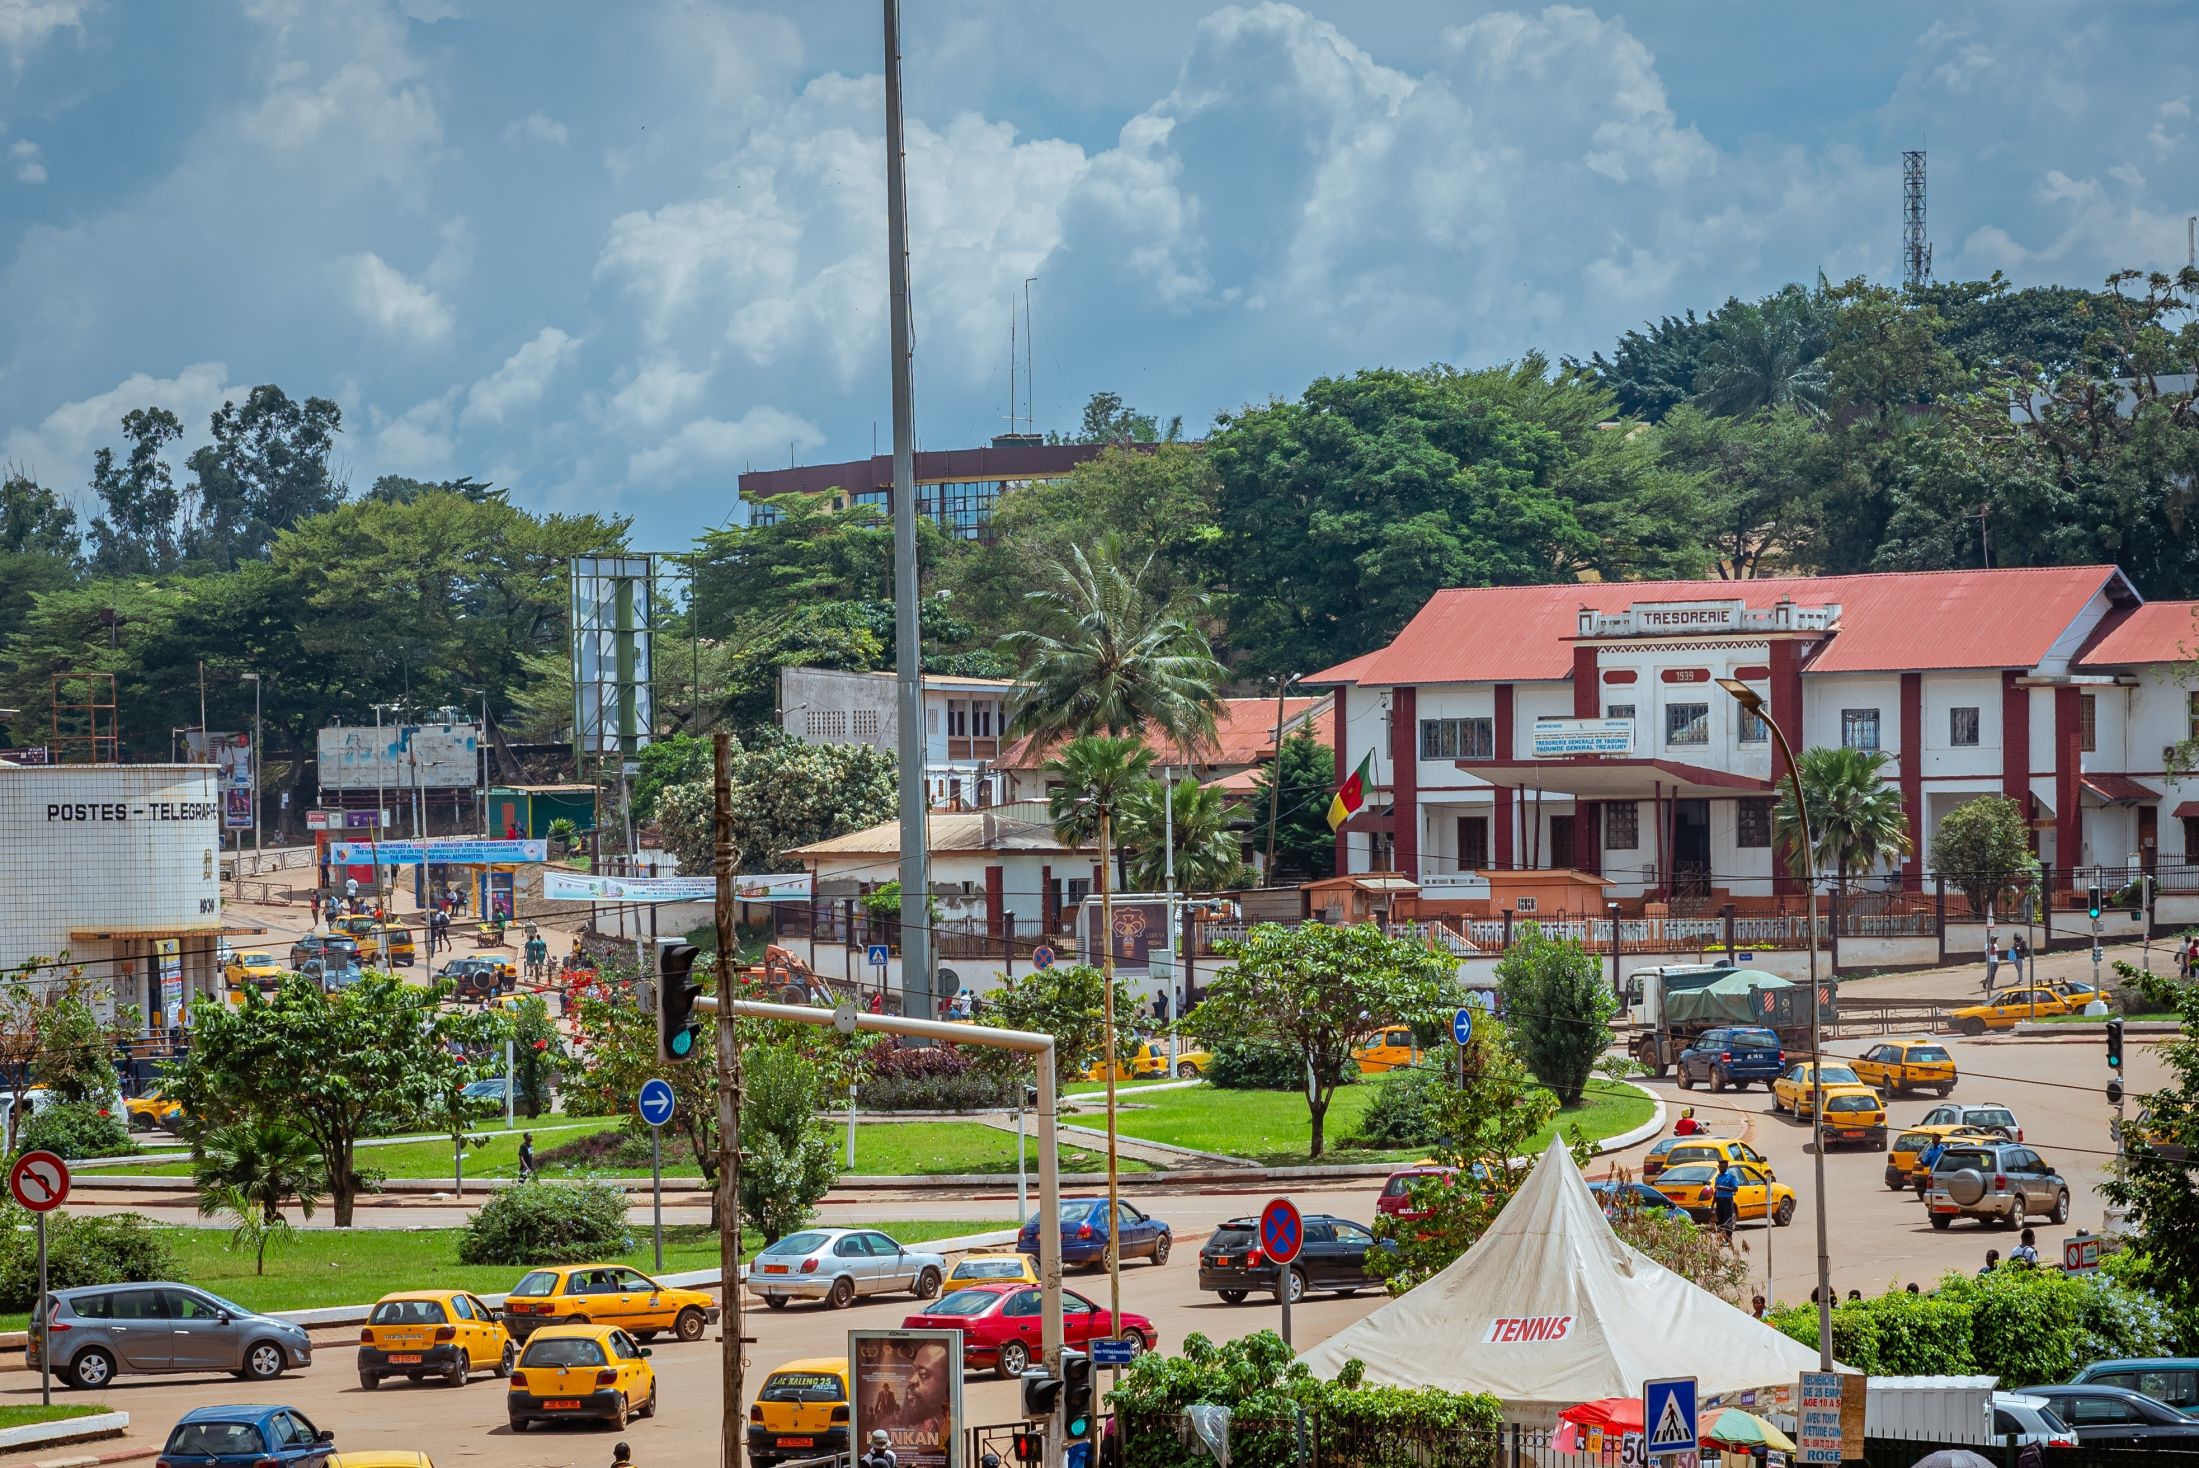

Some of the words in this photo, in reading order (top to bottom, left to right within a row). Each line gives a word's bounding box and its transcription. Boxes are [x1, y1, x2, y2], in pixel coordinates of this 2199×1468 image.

[1644, 610, 1730, 625] TRESORERIE
[1676, 671, 1694, 682] 1939
[48, 804, 127, 822] POSTES
[1491, 1316, 1571, 1342] TENNIS
[1804, 1387, 1813, 1397] DE
[1815, 1387, 1823, 1397] 25
[1803, 1398, 1818, 1407] AGE
[1829, 1399, 1835, 1407] A
[1806, 1412, 1821, 1424] AVEC
[1823, 1413, 1837, 1425] TOUT
[866, 1431, 939, 1446] KNKAN
